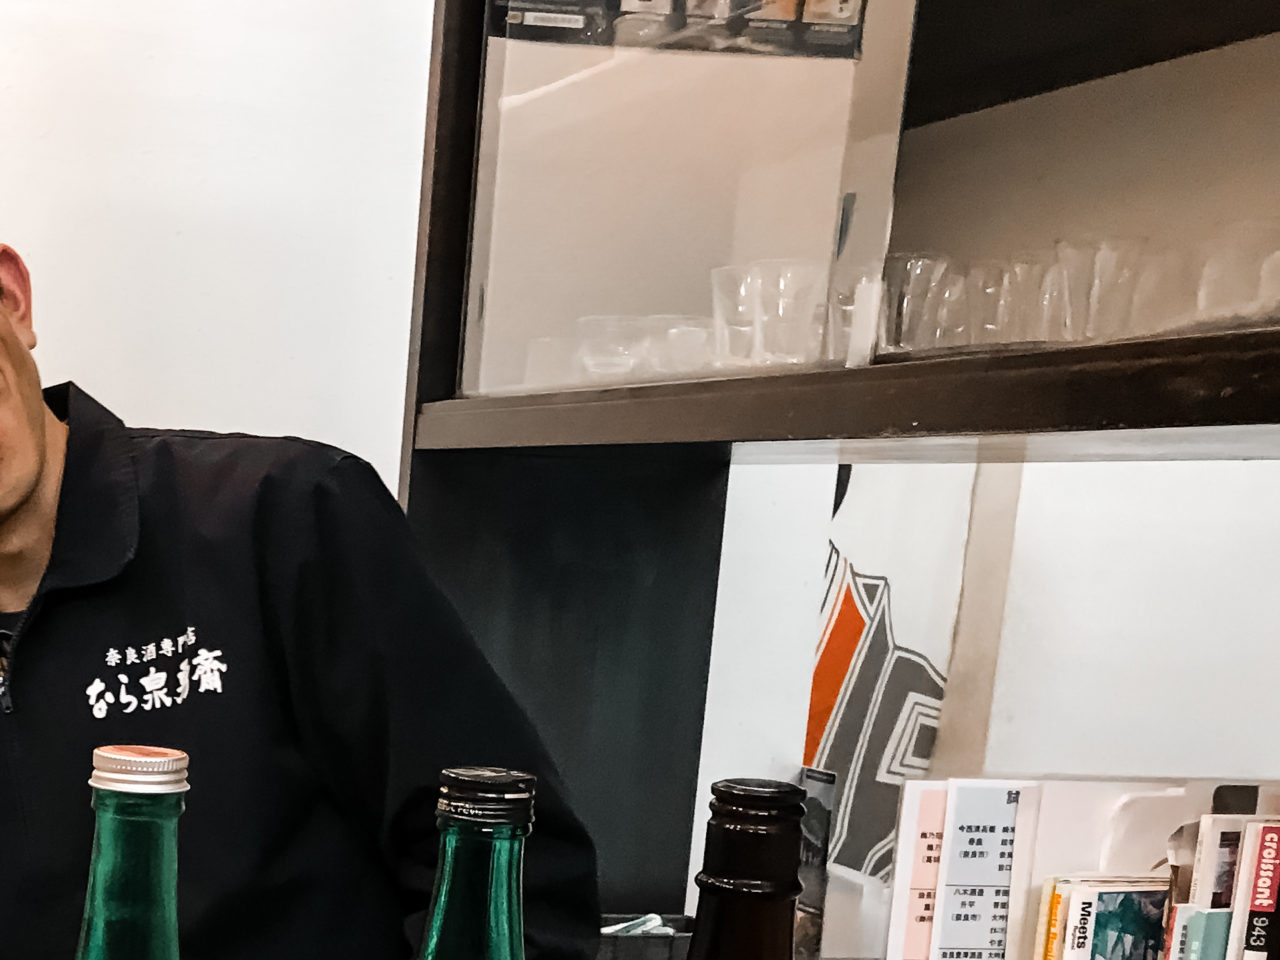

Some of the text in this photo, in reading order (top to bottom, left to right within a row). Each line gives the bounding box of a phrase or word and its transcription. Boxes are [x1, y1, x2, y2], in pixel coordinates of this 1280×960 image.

[1254, 833, 1280, 907] croissant
[1076, 901, 1092, 949] Meets
[1249, 917, 1269, 946] 943
